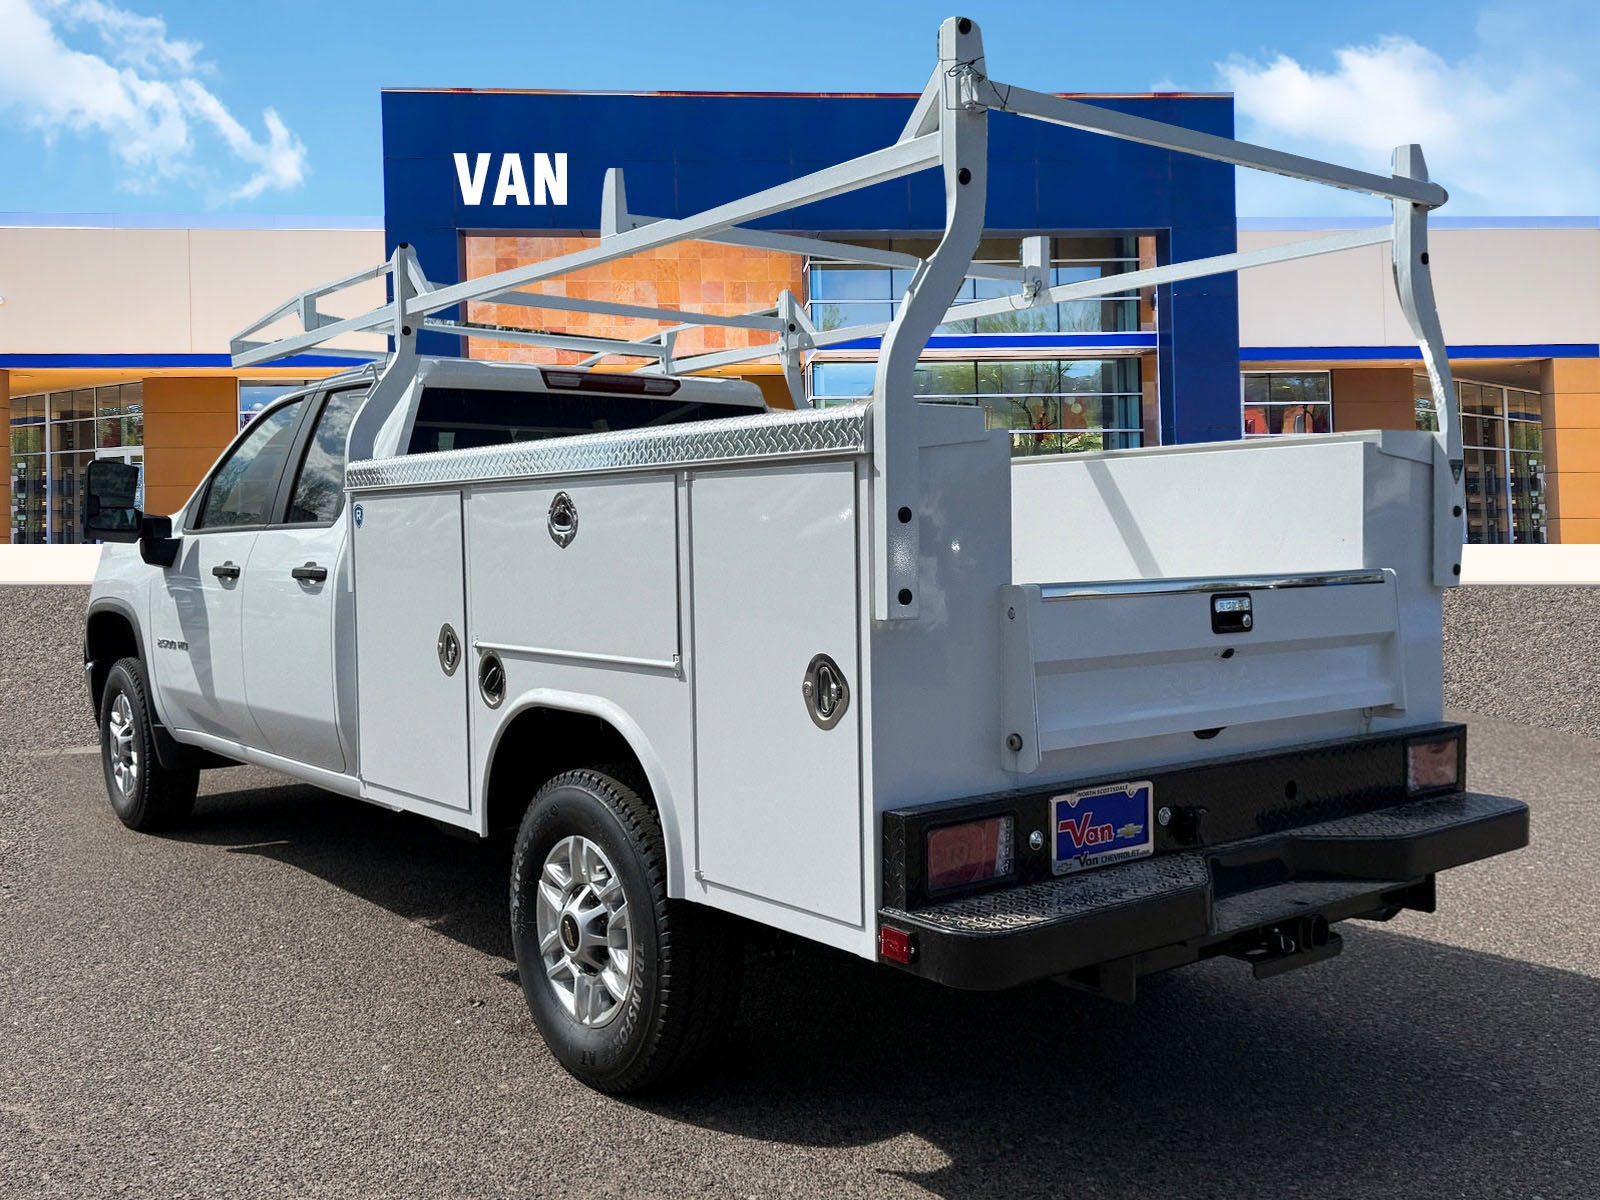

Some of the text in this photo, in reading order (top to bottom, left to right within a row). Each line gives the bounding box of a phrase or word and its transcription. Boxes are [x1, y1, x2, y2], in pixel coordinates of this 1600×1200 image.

[453, 153, 568, 206] VAN
[157, 638, 177, 650] 2500
[1096, 784, 1129, 796] SCOTTSDALE
[1058, 812, 1115, 848] Van
[1073, 850, 1099, 867] Van
